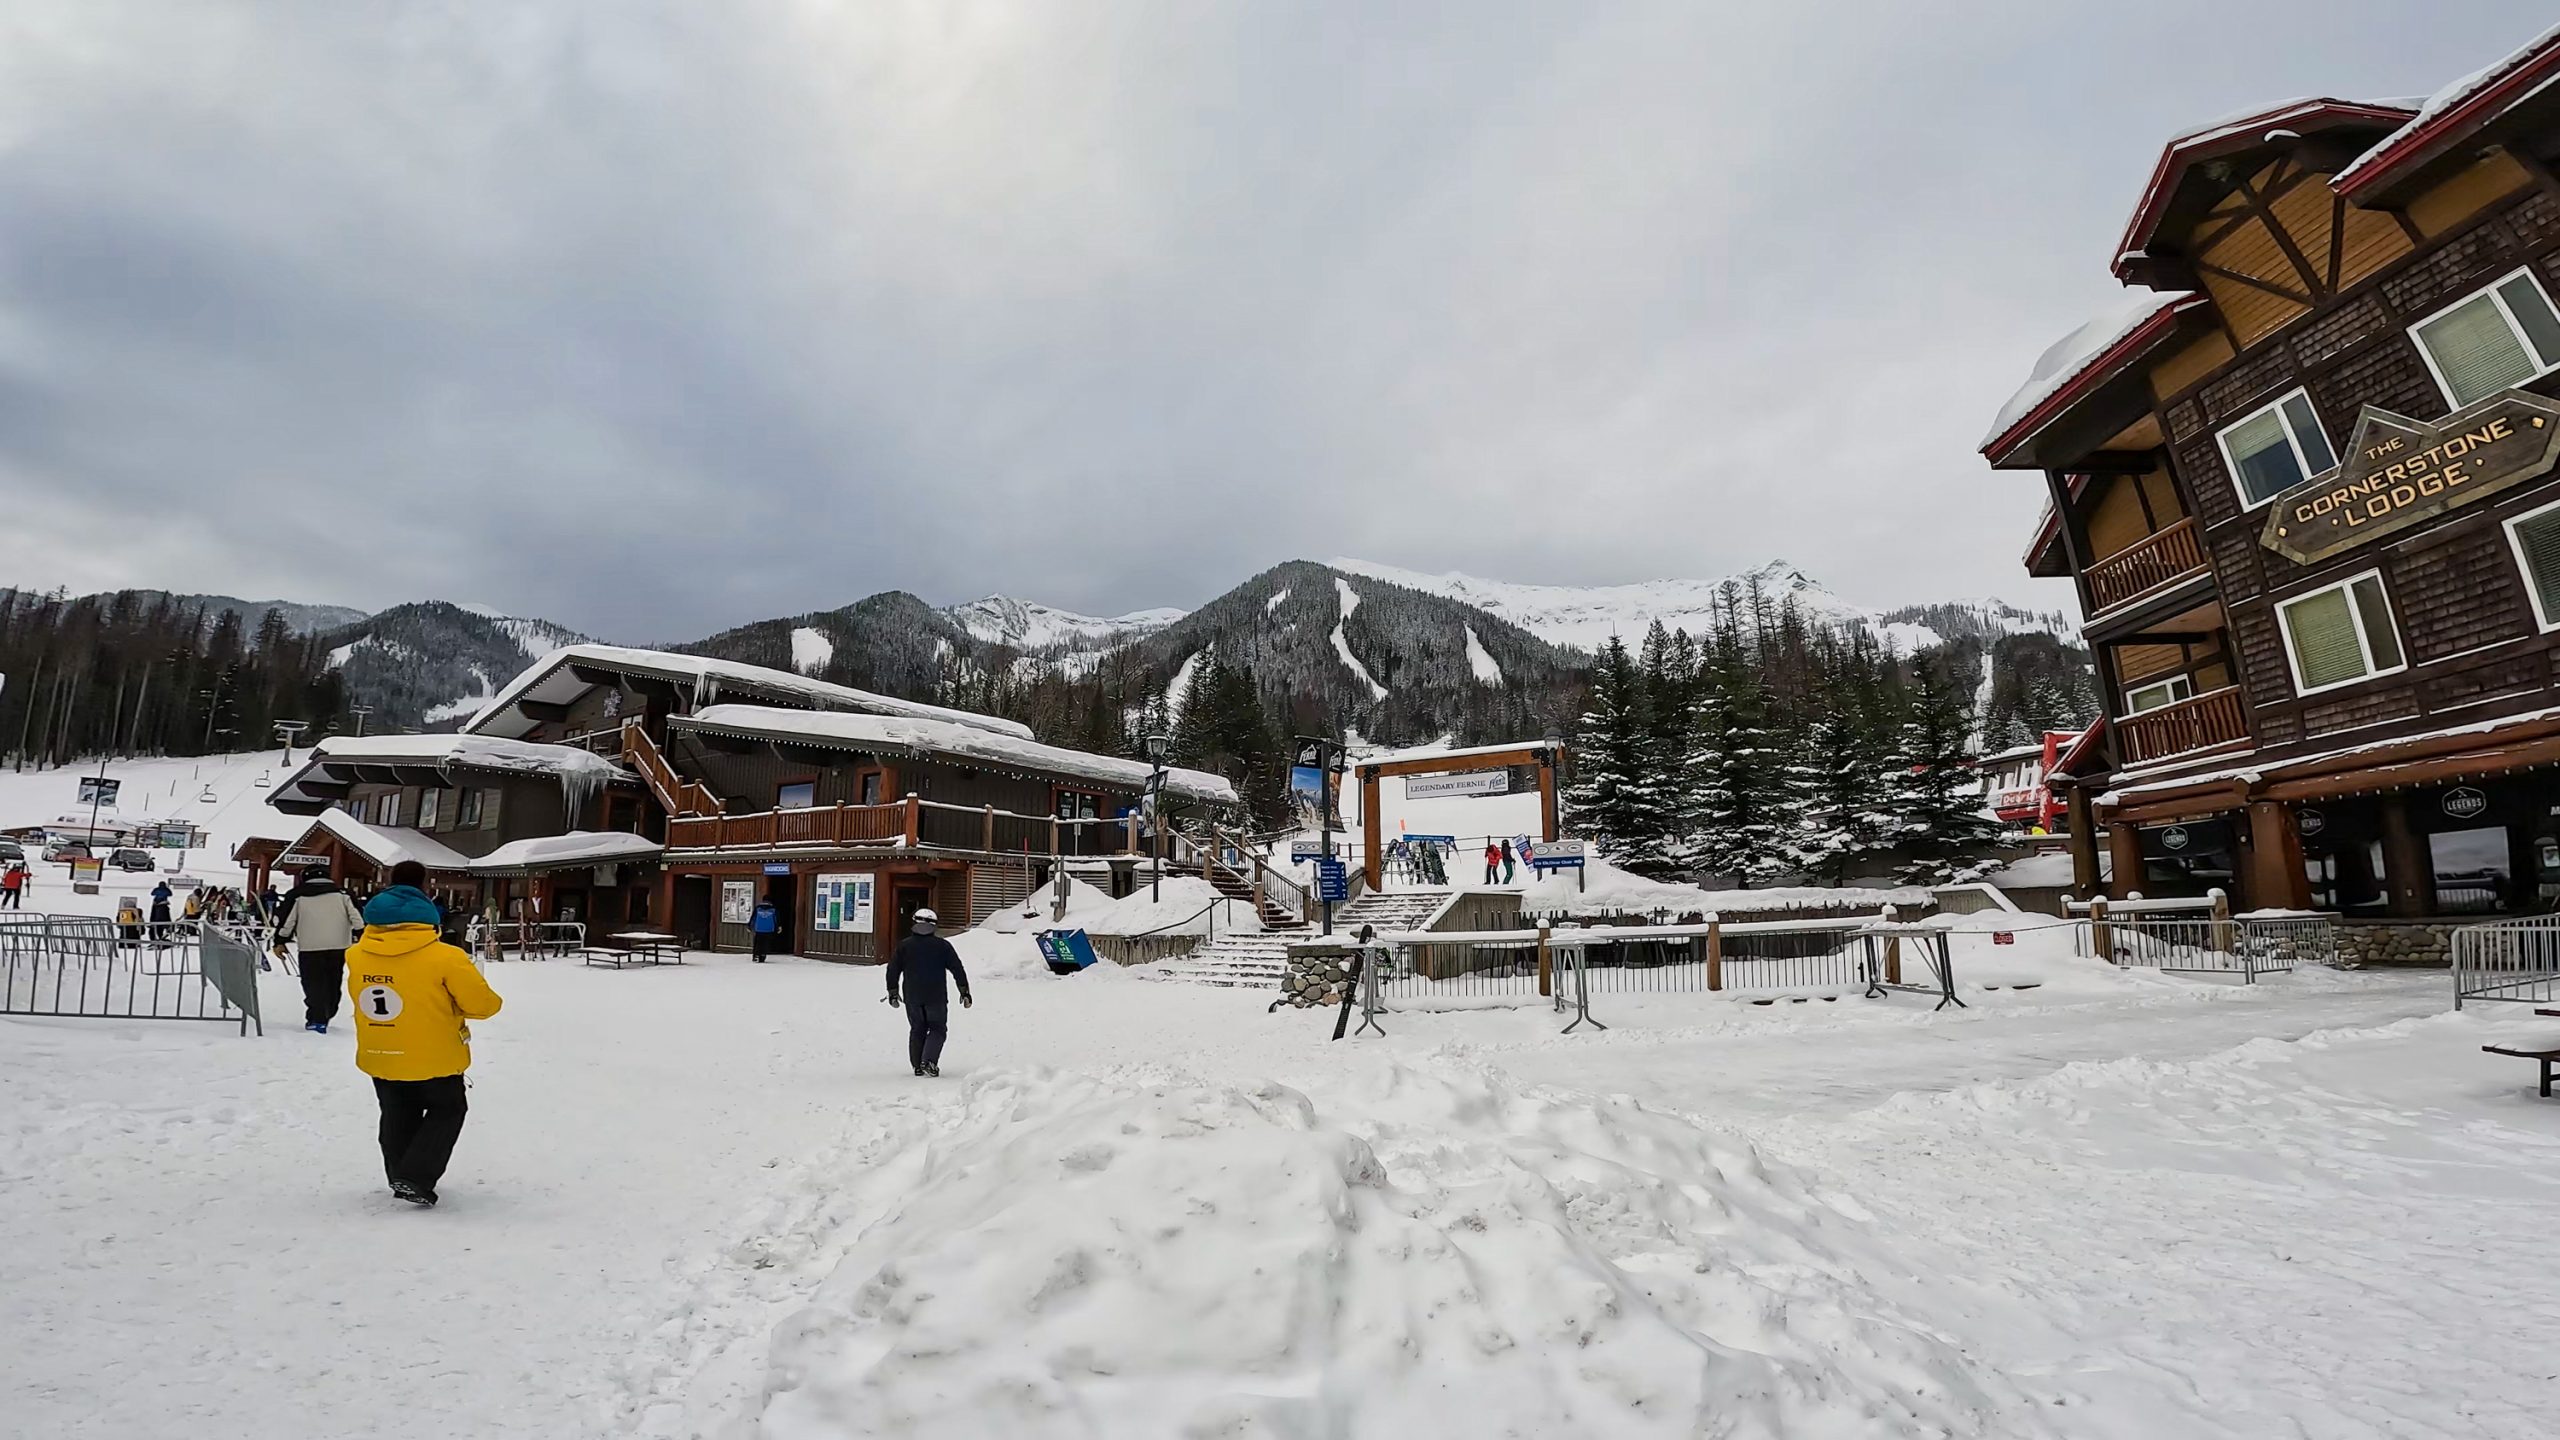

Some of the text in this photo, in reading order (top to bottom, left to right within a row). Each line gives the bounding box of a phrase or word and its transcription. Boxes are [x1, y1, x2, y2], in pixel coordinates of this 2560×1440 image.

[2364, 436, 2404, 460] THE
[2295, 417, 2513, 523] CORNERSTONE
[2344, 461, 2470, 527] LODGE
[1410, 780, 1486, 792] LEGENDARY FERNIE
[2447, 798, 2482, 811] LEGENDS
